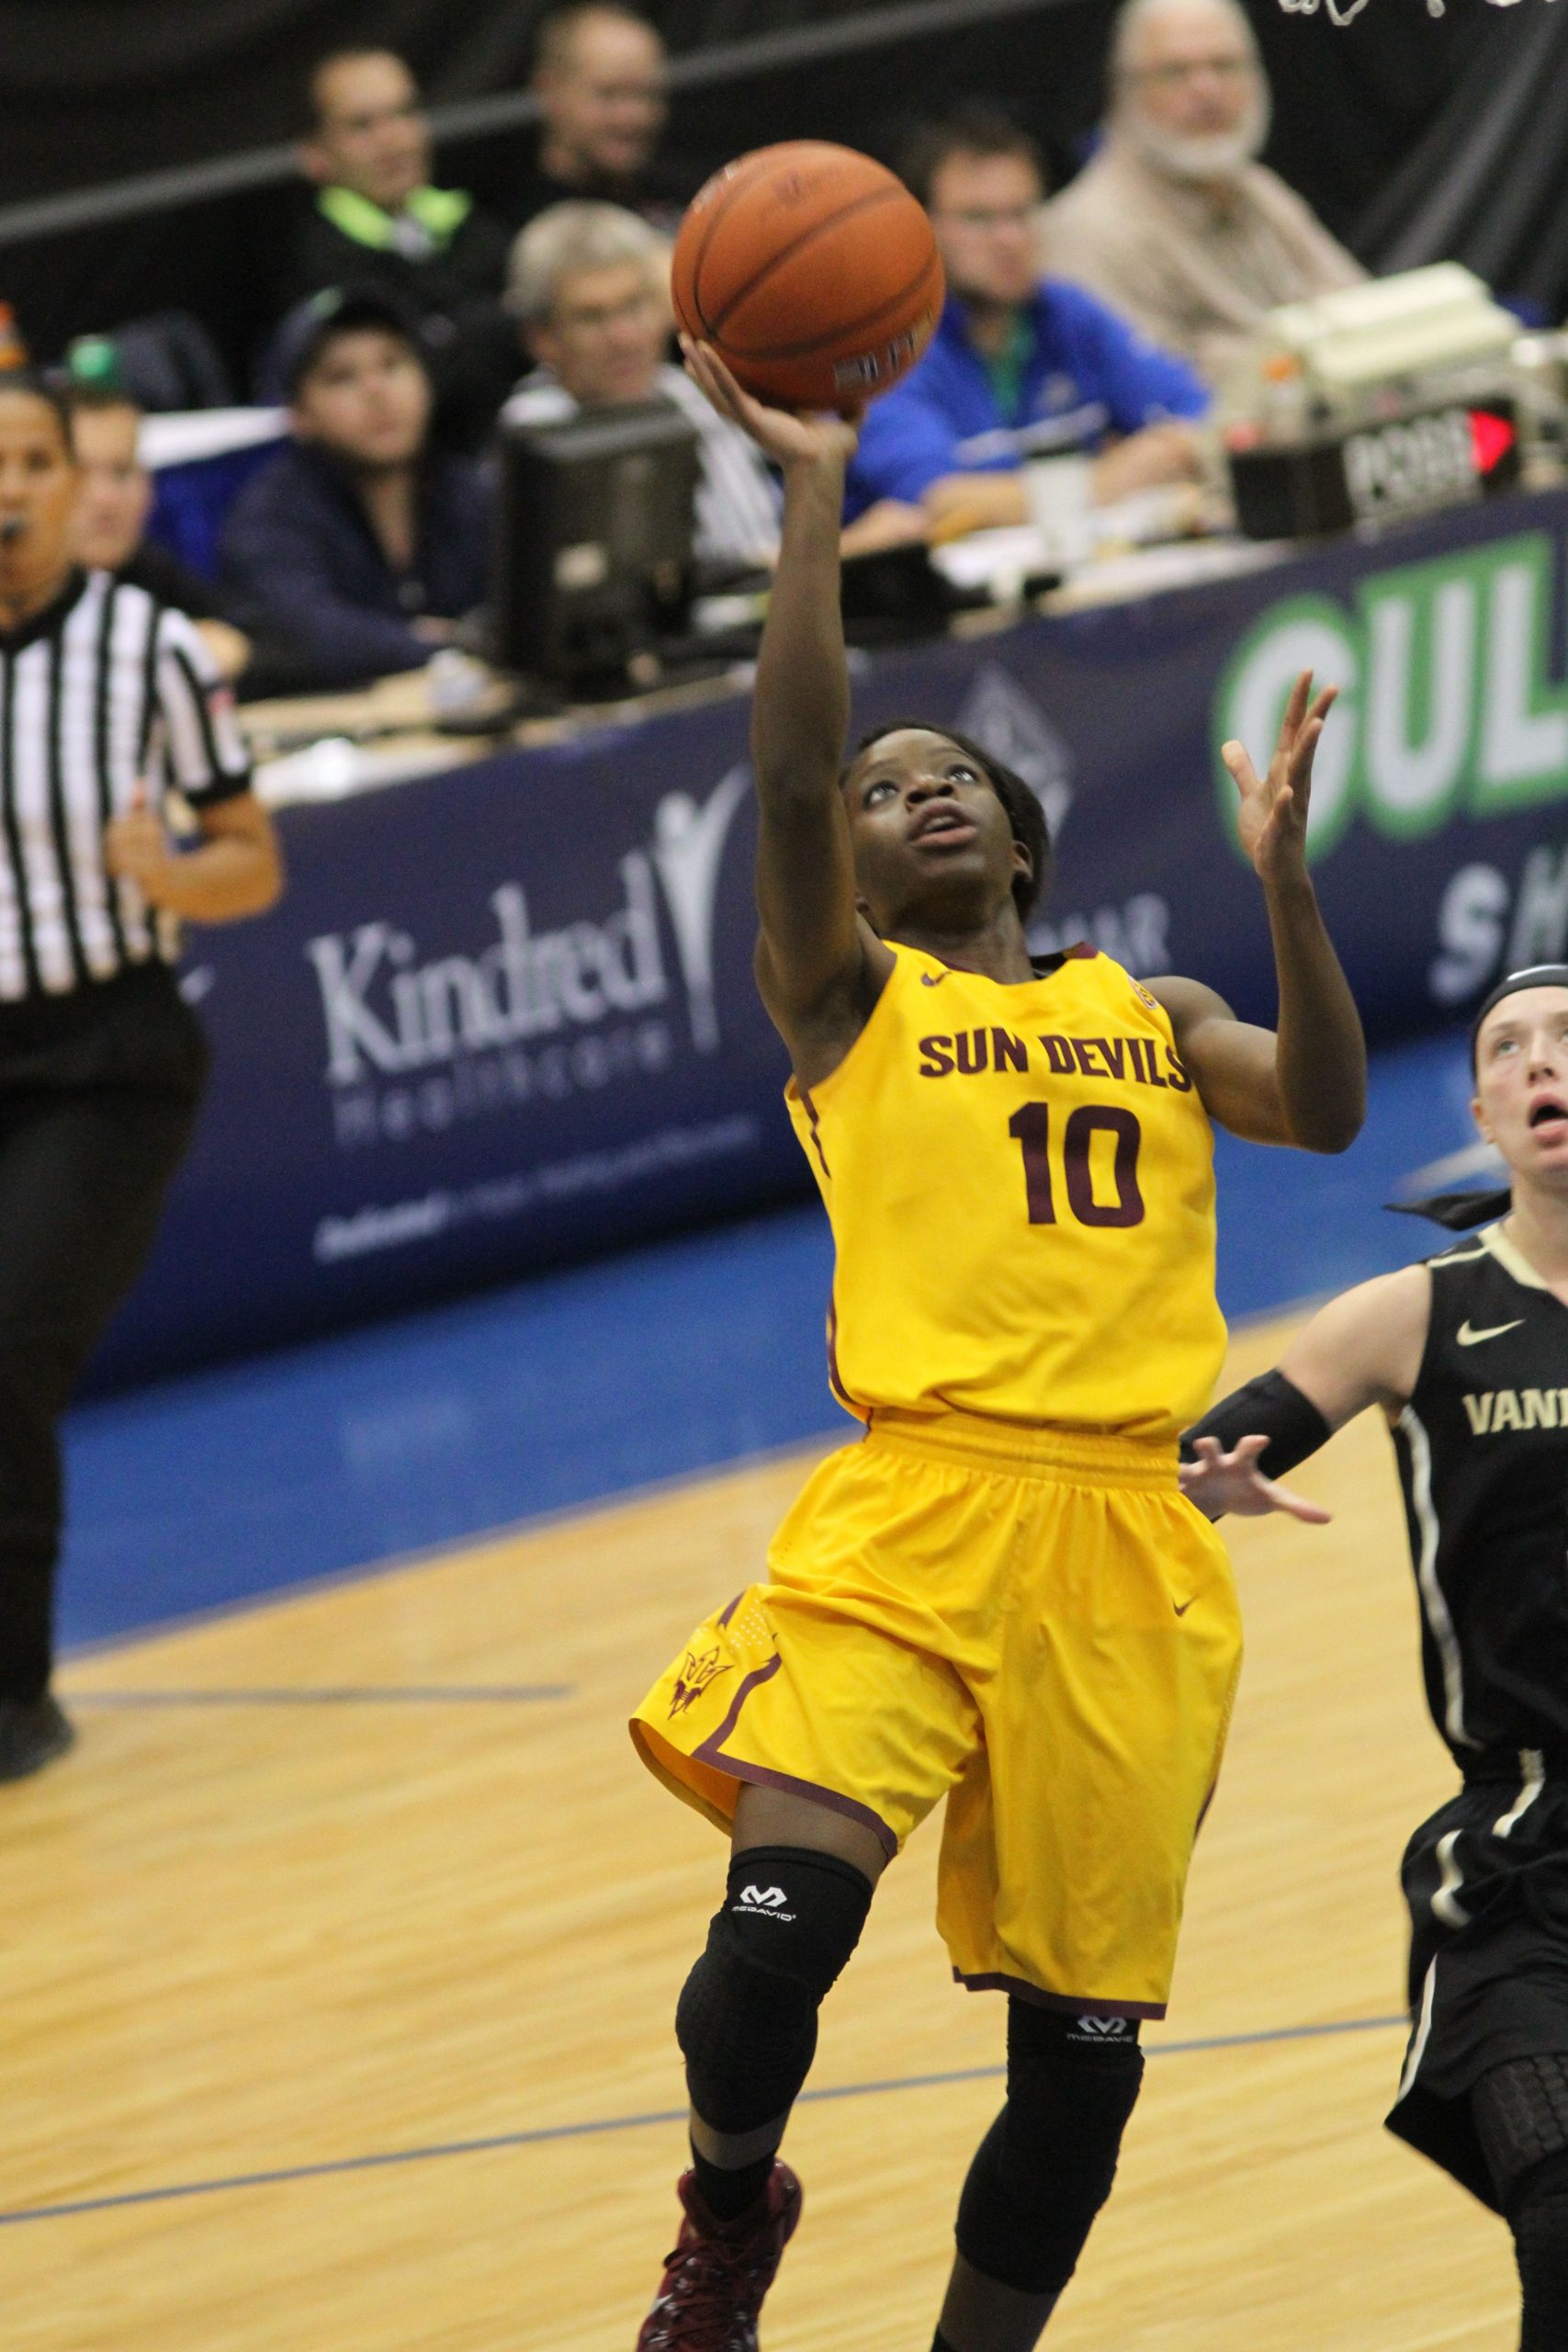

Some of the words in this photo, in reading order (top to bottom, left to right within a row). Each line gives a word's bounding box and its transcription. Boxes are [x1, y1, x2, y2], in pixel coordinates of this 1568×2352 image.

[307, 849, 669, 1086] Kindred
[919, 1026, 1030, 1078] SUN
[1037, 1035, 1192, 1092] DEVILS
[1009, 1102, 1145, 1227] 10
[1461, 1388, 1568, 1435] VAN
